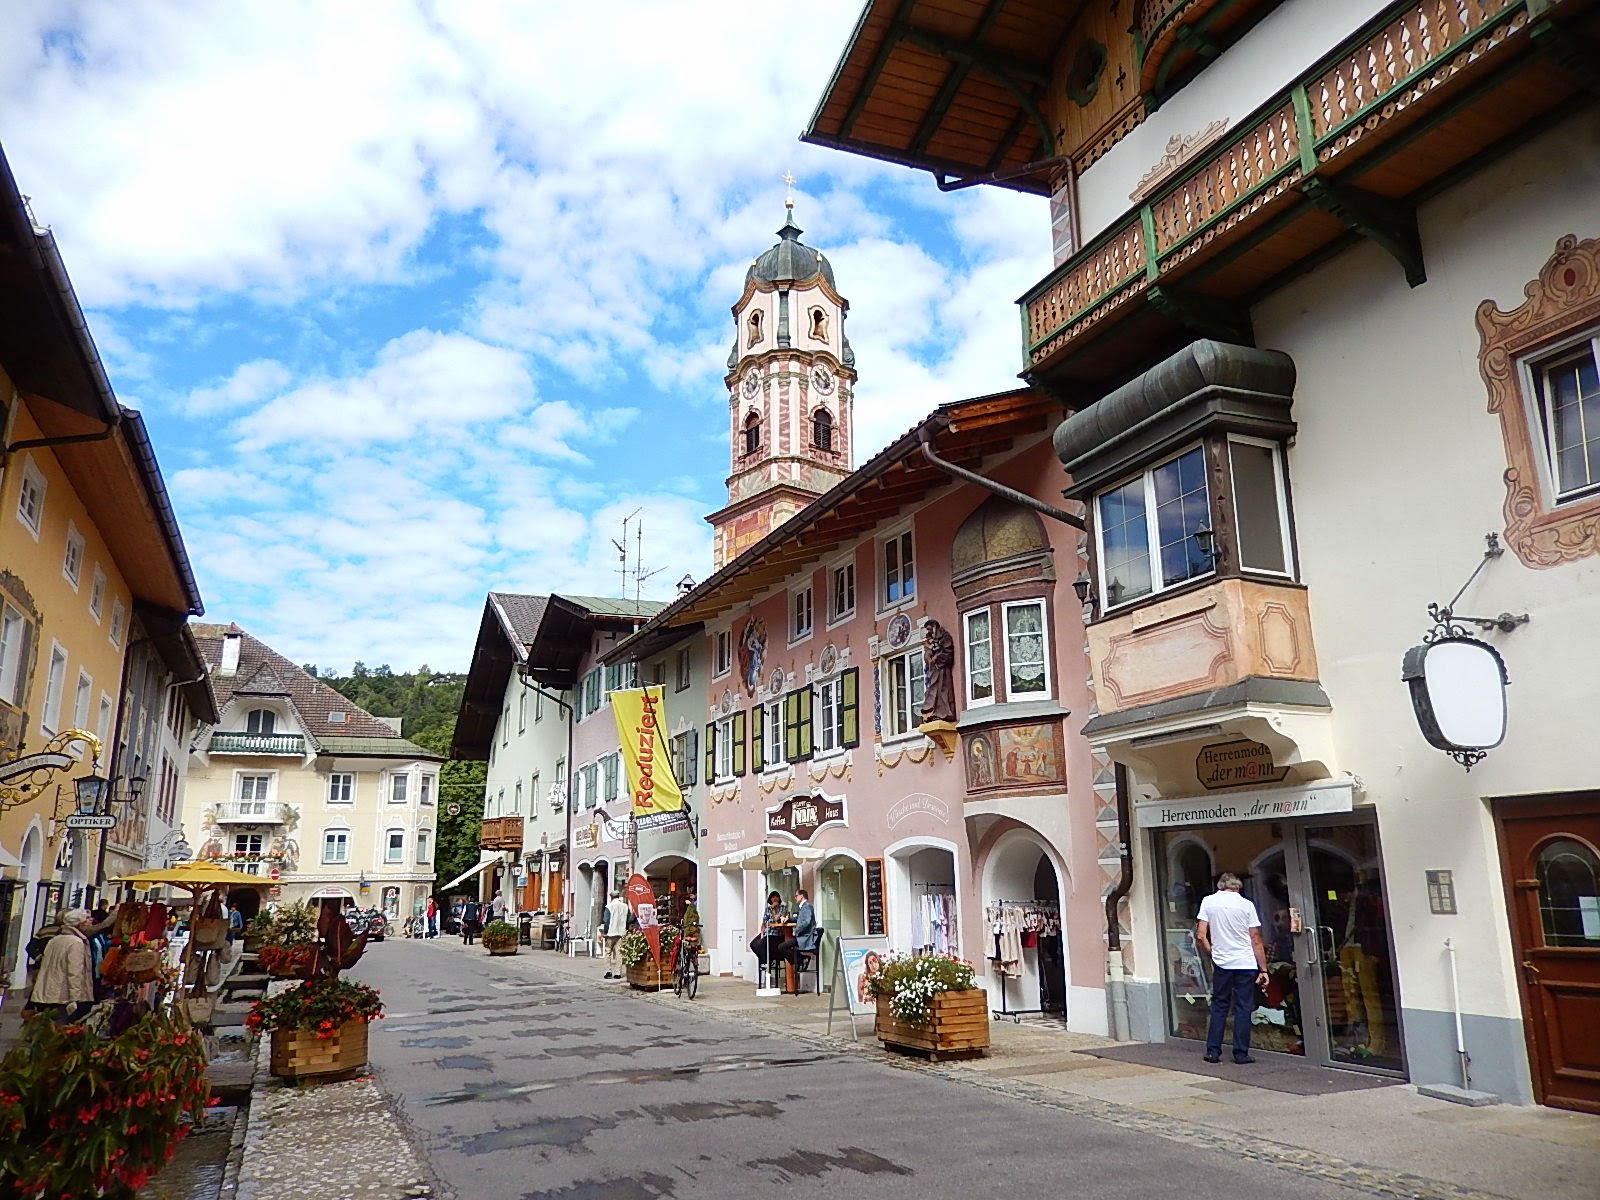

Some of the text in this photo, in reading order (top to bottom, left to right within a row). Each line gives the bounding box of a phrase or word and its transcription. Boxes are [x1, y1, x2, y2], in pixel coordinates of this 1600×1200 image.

[635, 695, 658, 808] Reduziert
[1204, 744, 1272, 764] Herrenmode
[70, 818, 112, 826] OPTIKER
[1161, 804, 1237, 823] Herrenmoden
